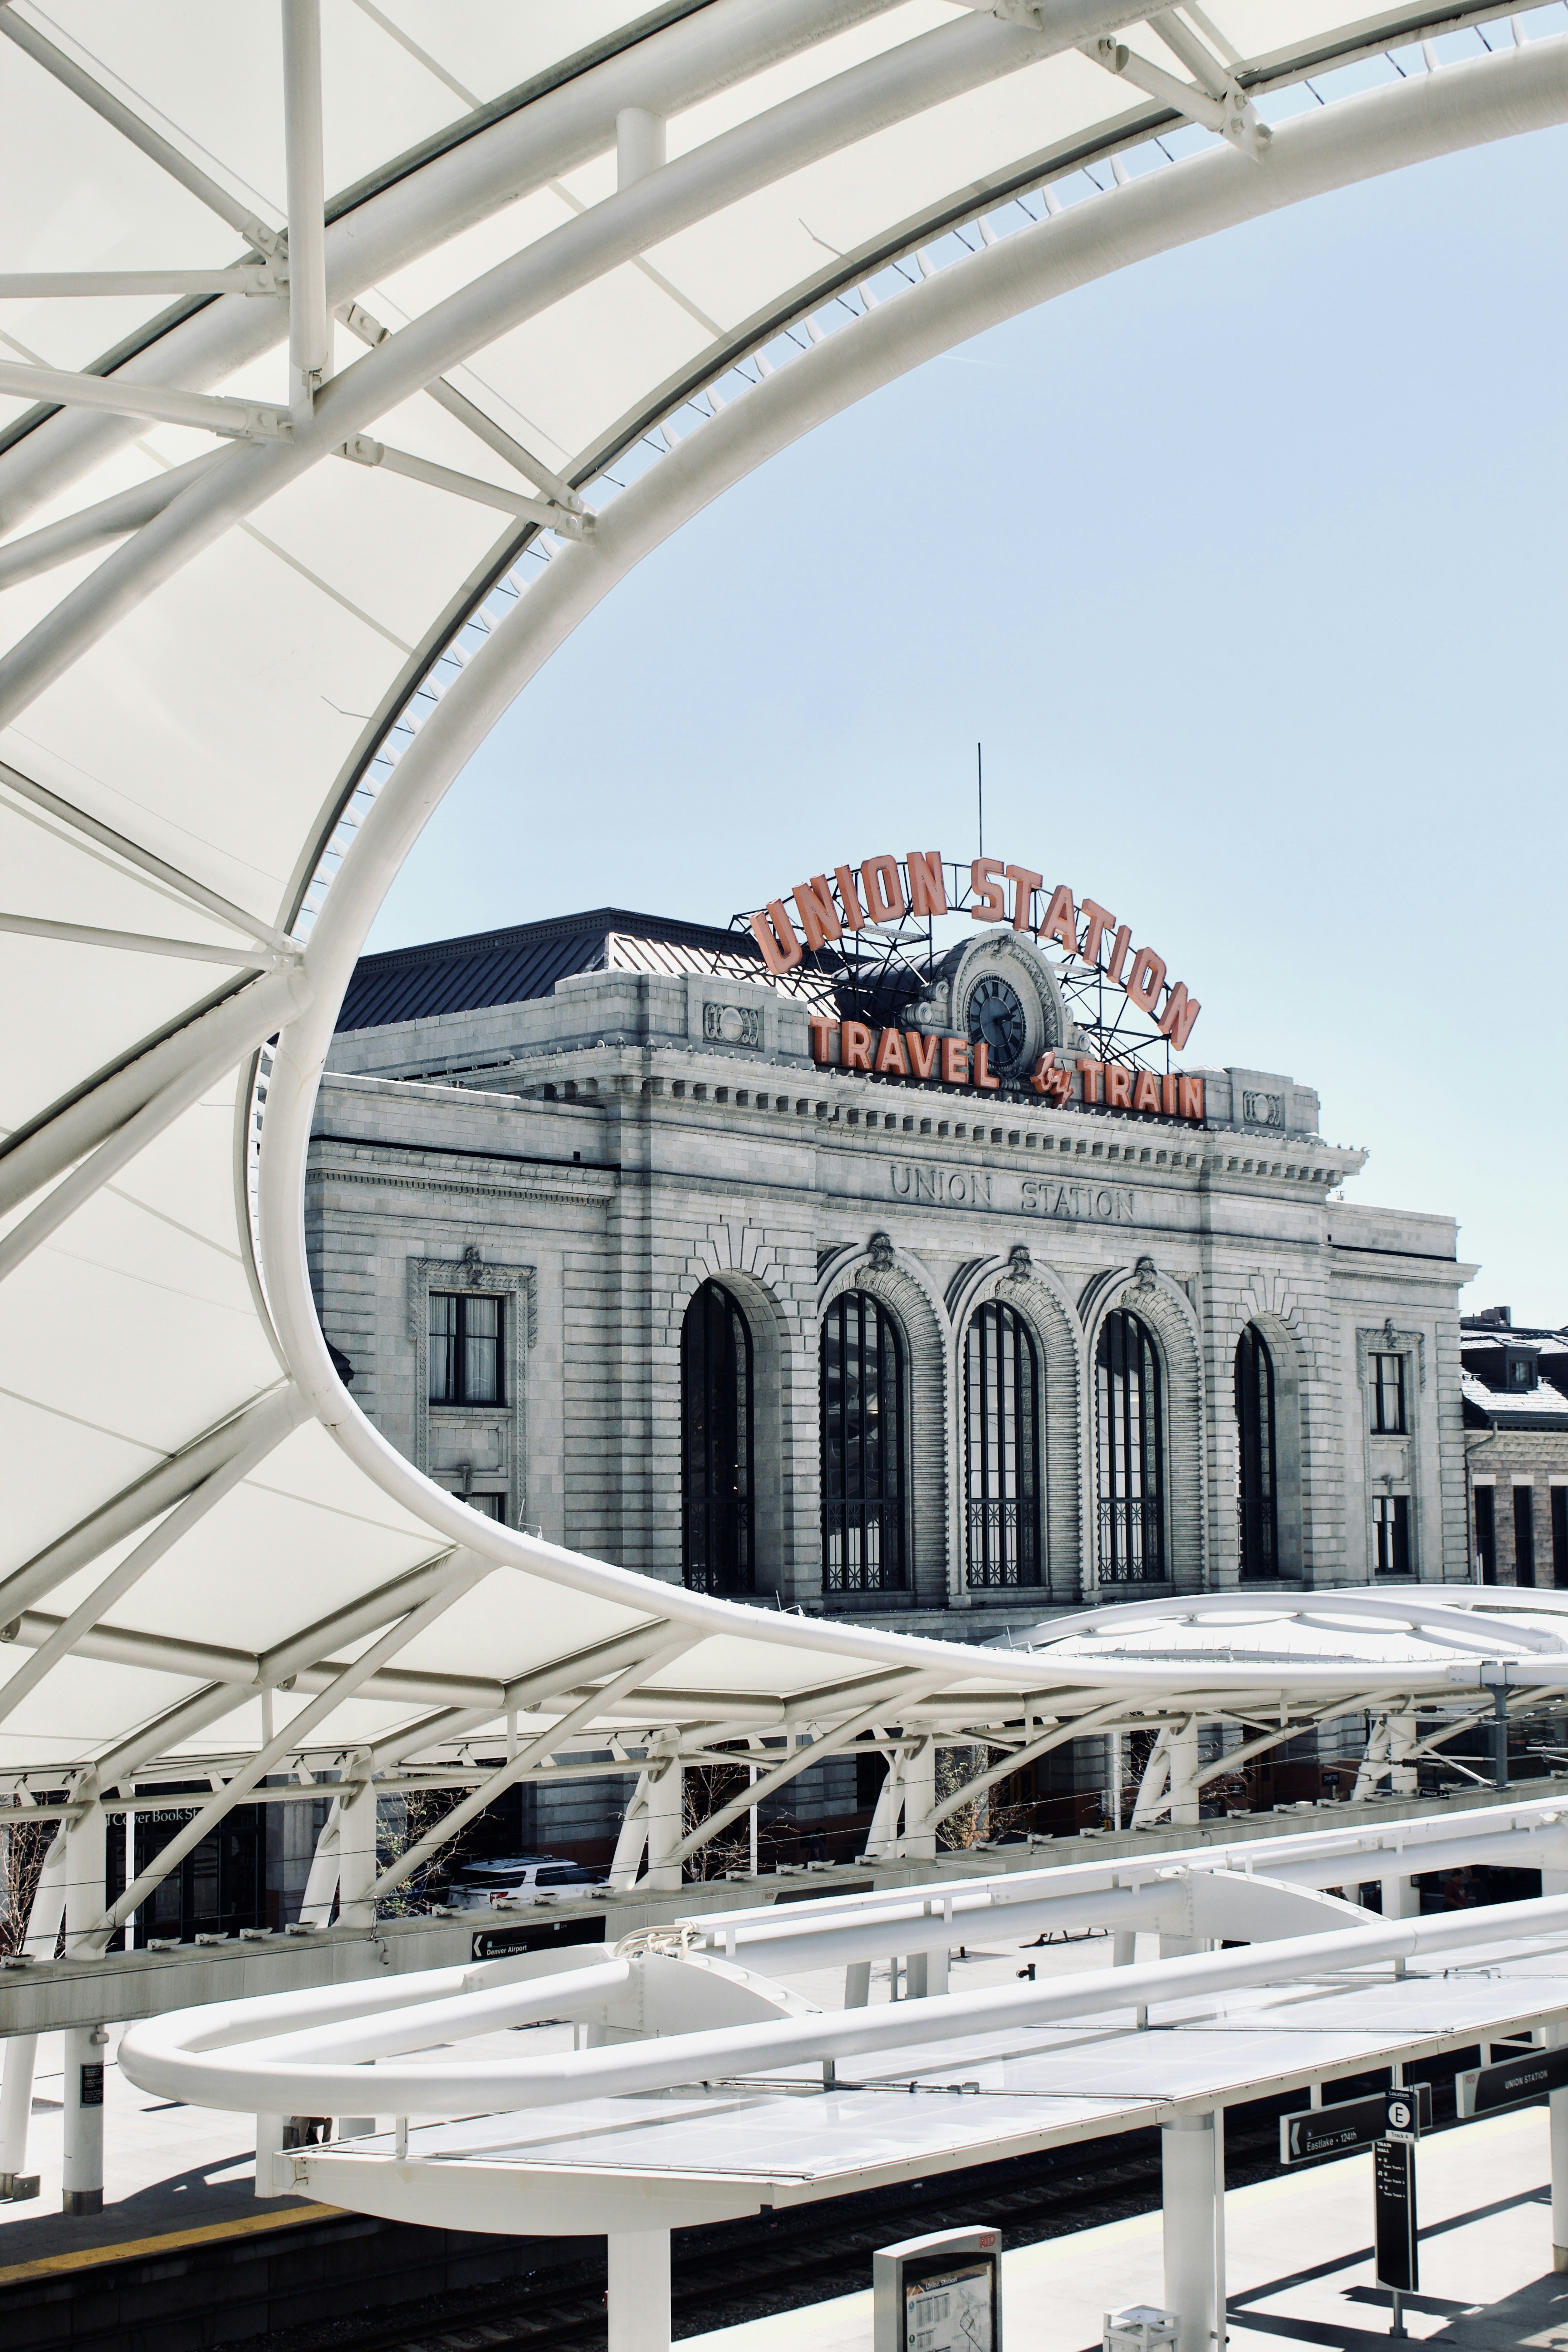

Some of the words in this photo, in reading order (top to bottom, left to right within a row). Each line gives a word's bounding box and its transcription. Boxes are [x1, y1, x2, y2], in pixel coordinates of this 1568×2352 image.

[749, 851, 947, 975] UNION
[971, 857, 1201, 1051] STATION
[810, 1016, 1000, 1088] TRAVEL
[1030, 1051, 1073, 1108] by
[1077, 1059, 1203, 1120] TRAIN
[890, 1166, 991, 1205] UNION
[1022, 1181, 1134, 1220] STATION
[152, 1808, 184, 1823] Book
[487, 1948, 506, 1956] Denver
[508, 1944, 527, 1954] Airport
[1504, 2076, 1523, 2089] UNION
[1524, 2069, 1548, 2084] STATION
[1396, 2107, 1403, 2123] E
[1307, 2137, 1334, 2151] Eastlake
[1340, 2131, 1357, 2142] 124th
[980, 2234, 996, 2249] RTD
[926, 2281, 940, 2290] Union
[940, 2277, 958, 2286] Station
